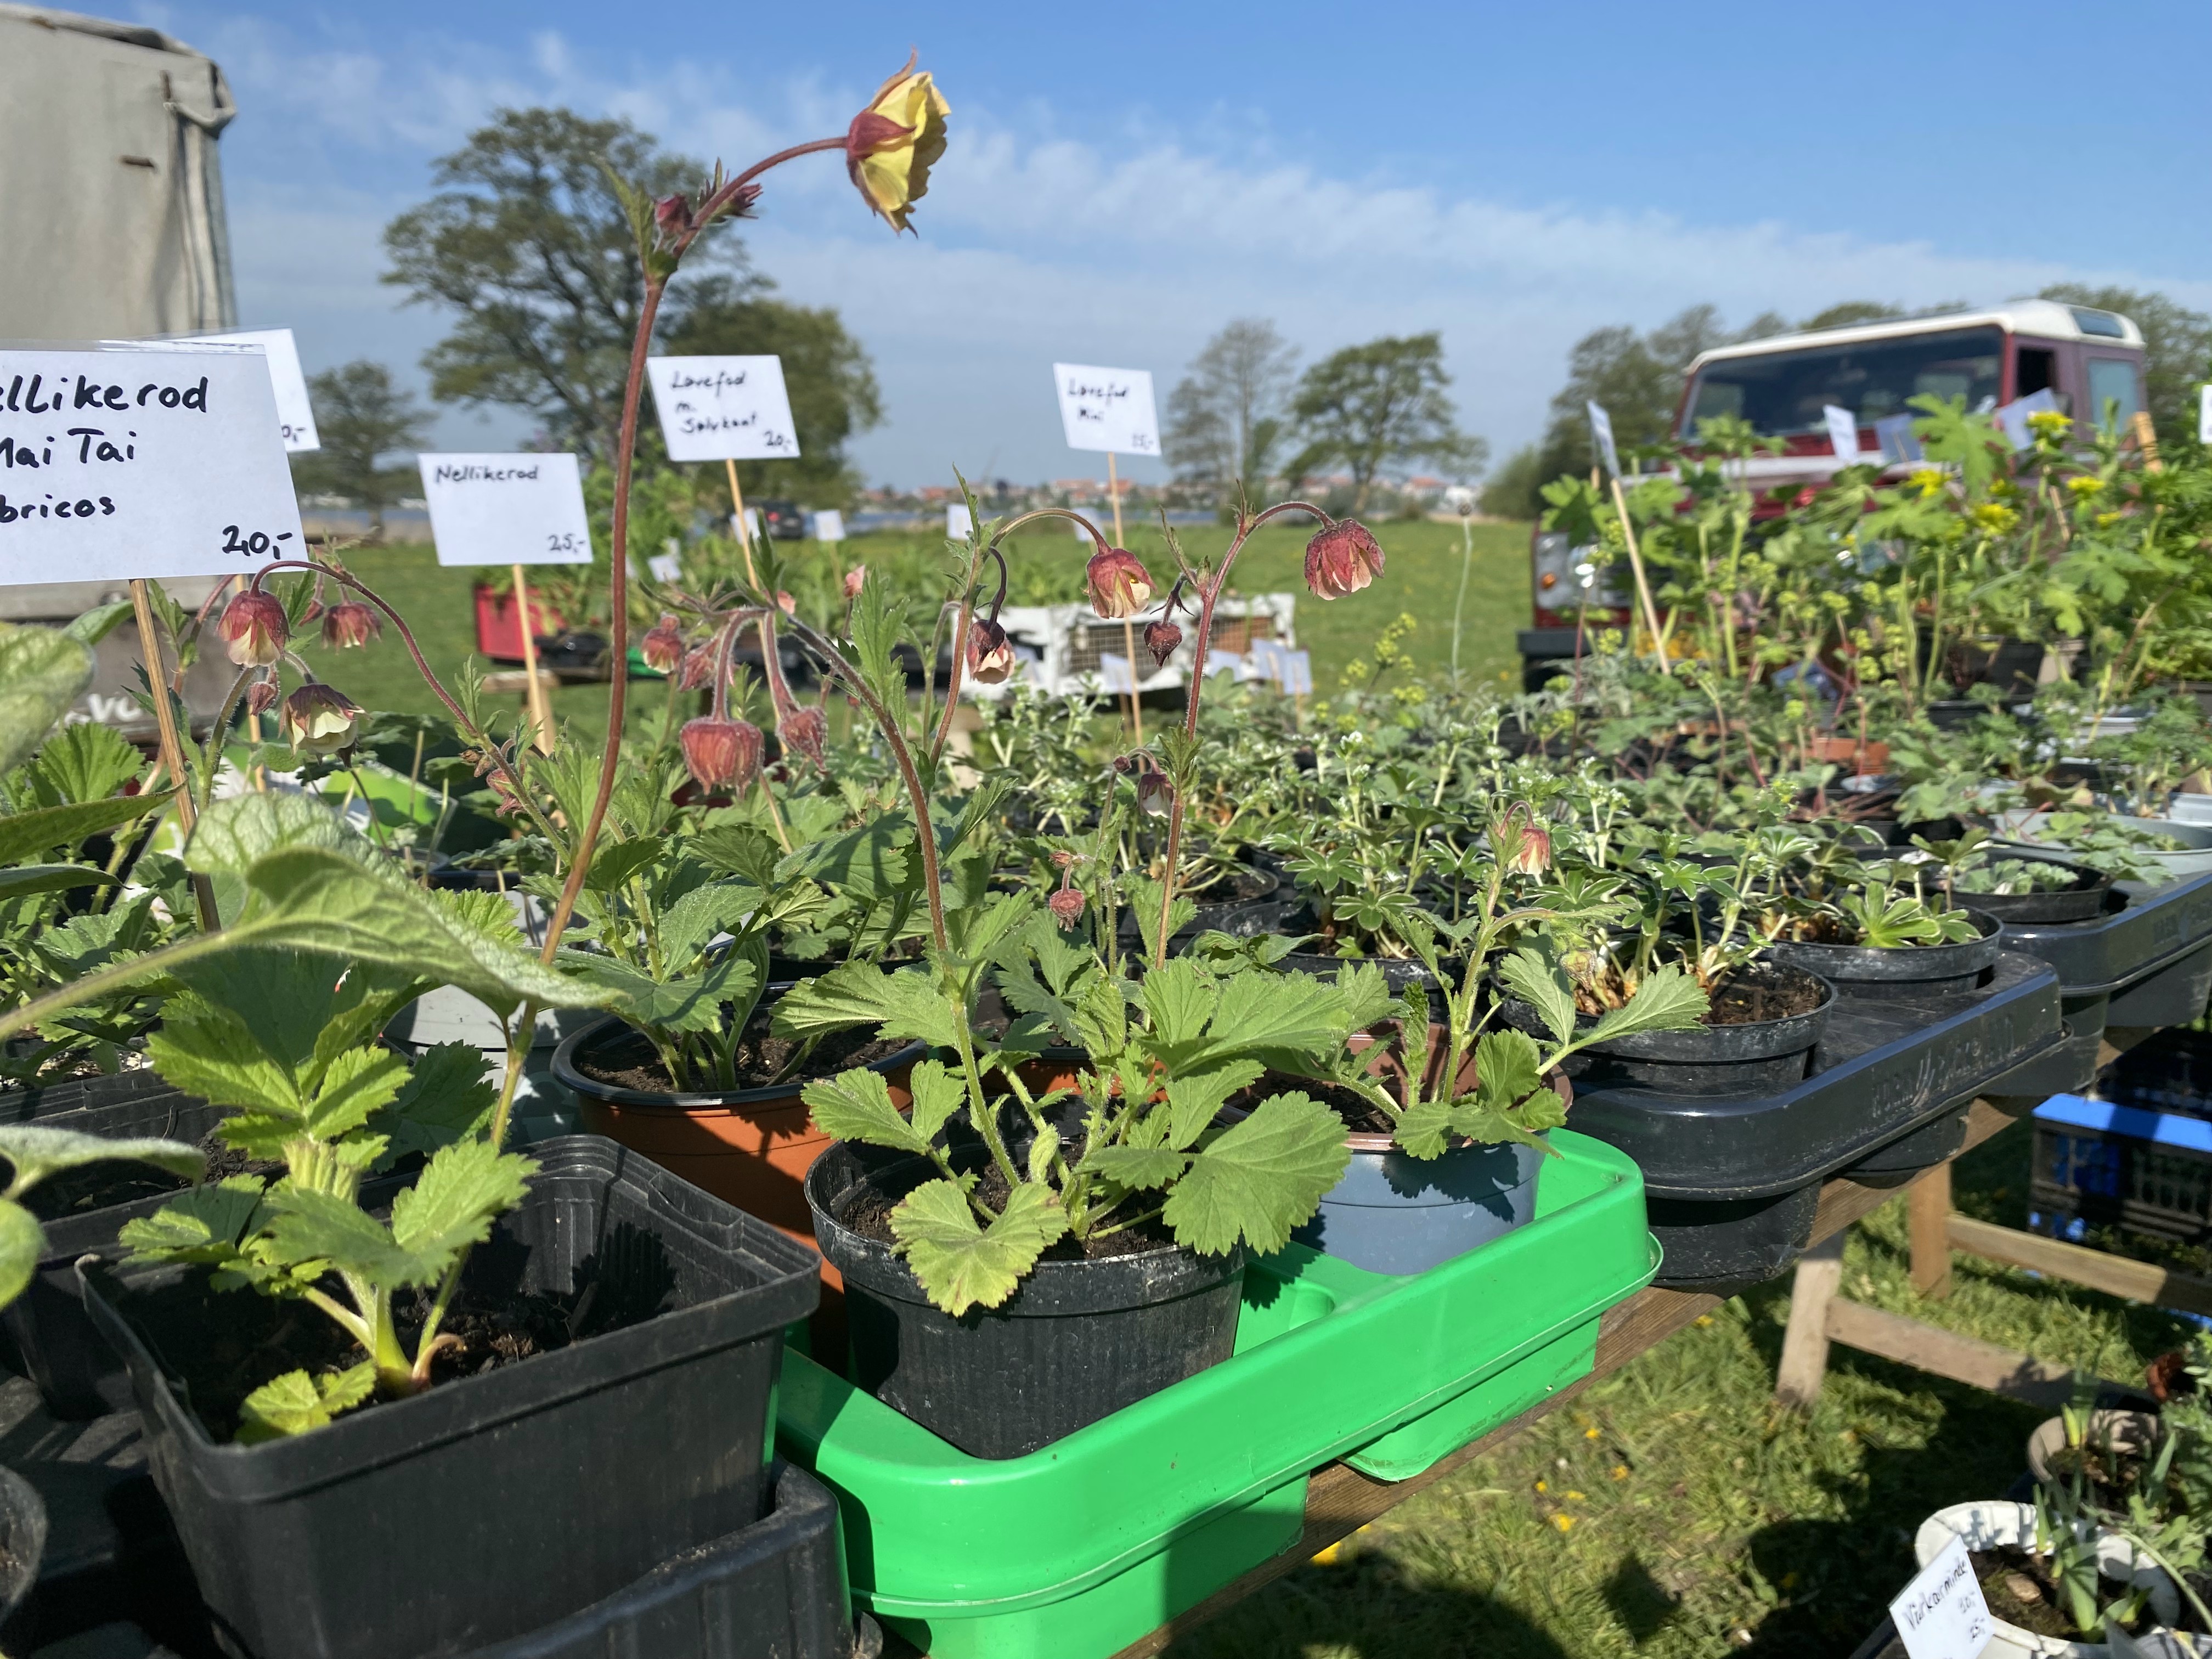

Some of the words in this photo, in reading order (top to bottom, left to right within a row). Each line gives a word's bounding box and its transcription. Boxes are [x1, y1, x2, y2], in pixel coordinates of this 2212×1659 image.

[0, 374, 208, 413] llikerod
[67, 427, 137, 464] Tai
[435, 464, 540, 484] Nellikerod
[222, 524, 293, 560] 20,-
[548, 532, 586, 553] 25,-
